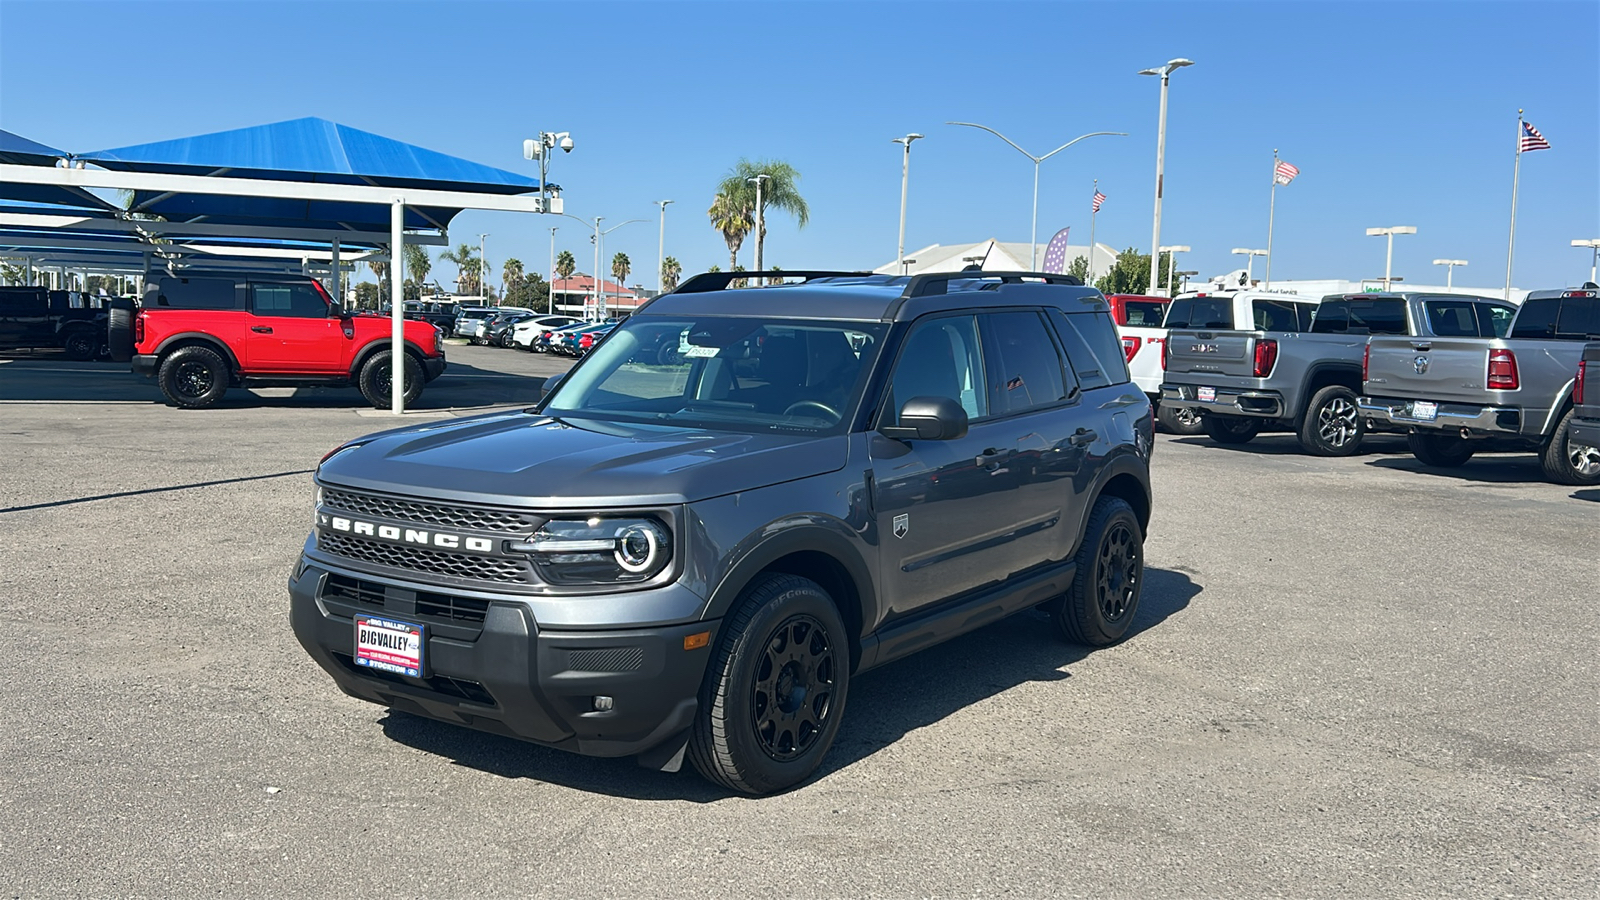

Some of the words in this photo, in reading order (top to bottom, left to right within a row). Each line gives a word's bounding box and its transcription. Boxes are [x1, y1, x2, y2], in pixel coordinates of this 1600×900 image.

[332, 516, 493, 552] BRONCO
[370, 618, 382, 626] BIG
[382, 620, 406, 631] VALLEY
[360, 629, 409, 652] BIGVALLEY
[368, 660, 406, 674] STOCKTON
